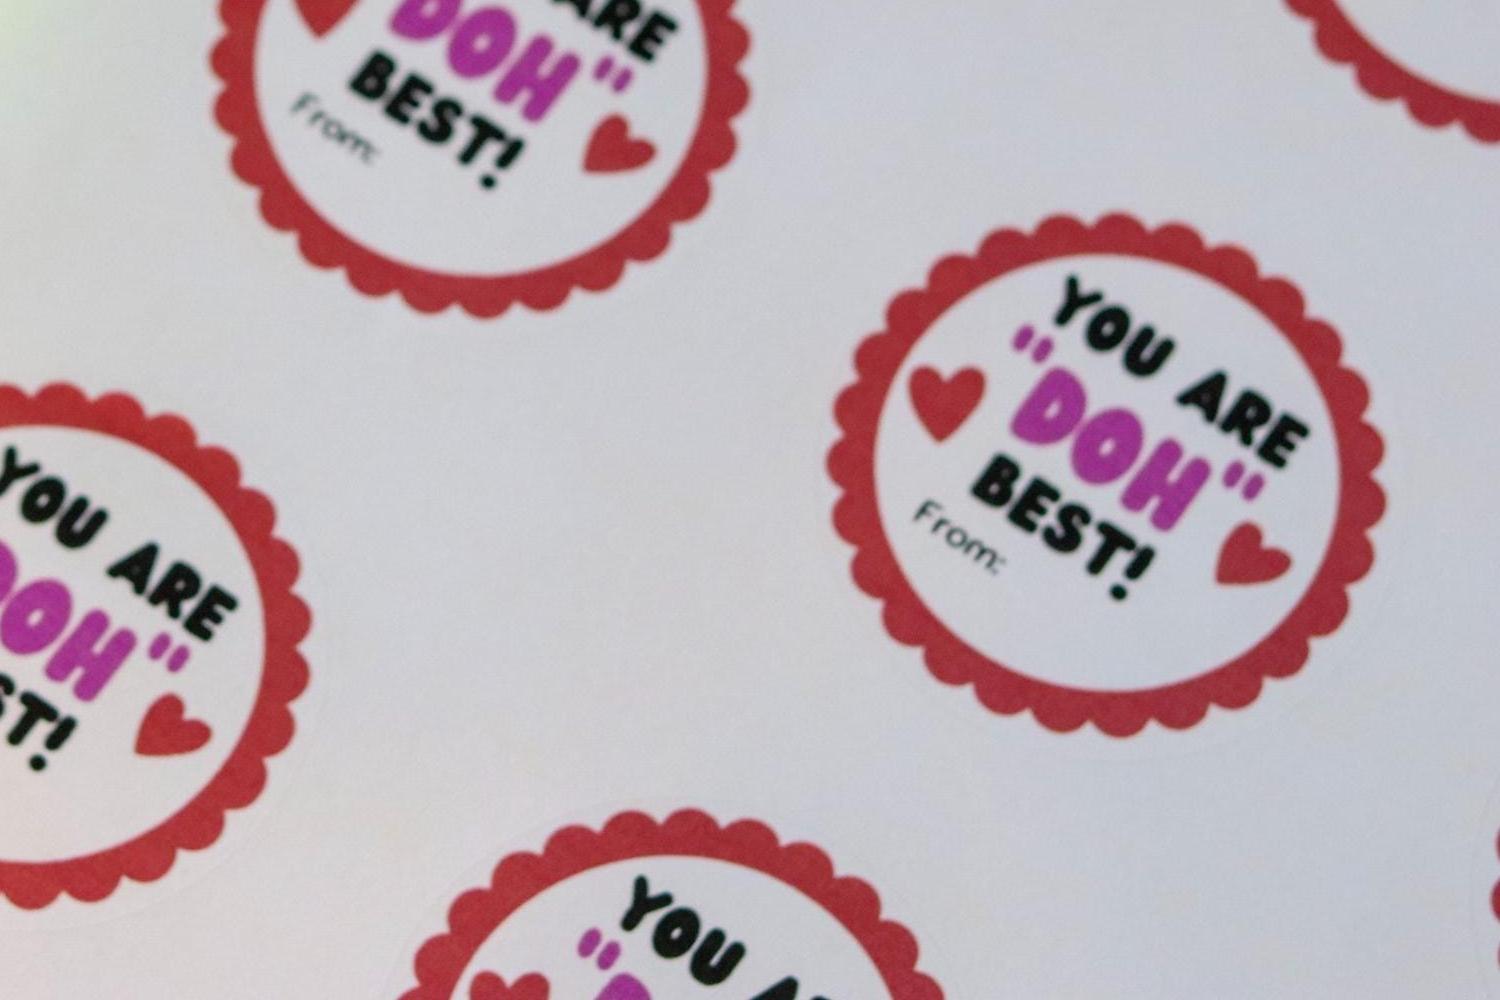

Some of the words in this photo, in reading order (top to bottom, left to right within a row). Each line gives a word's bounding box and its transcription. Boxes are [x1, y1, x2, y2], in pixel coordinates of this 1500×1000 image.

[347, 48, 527, 190] BEST!
[1010, 324, 1266, 532] "DOH"
[1052, 273, 1176, 379] YOU
[1175, 370, 1310, 470] ARE
[106, 541, 240, 643] ARE
[912, 498, 1006, 575] From:
[970, 452, 1156, 602] BEST!
[620, 875, 746, 986] YOU
